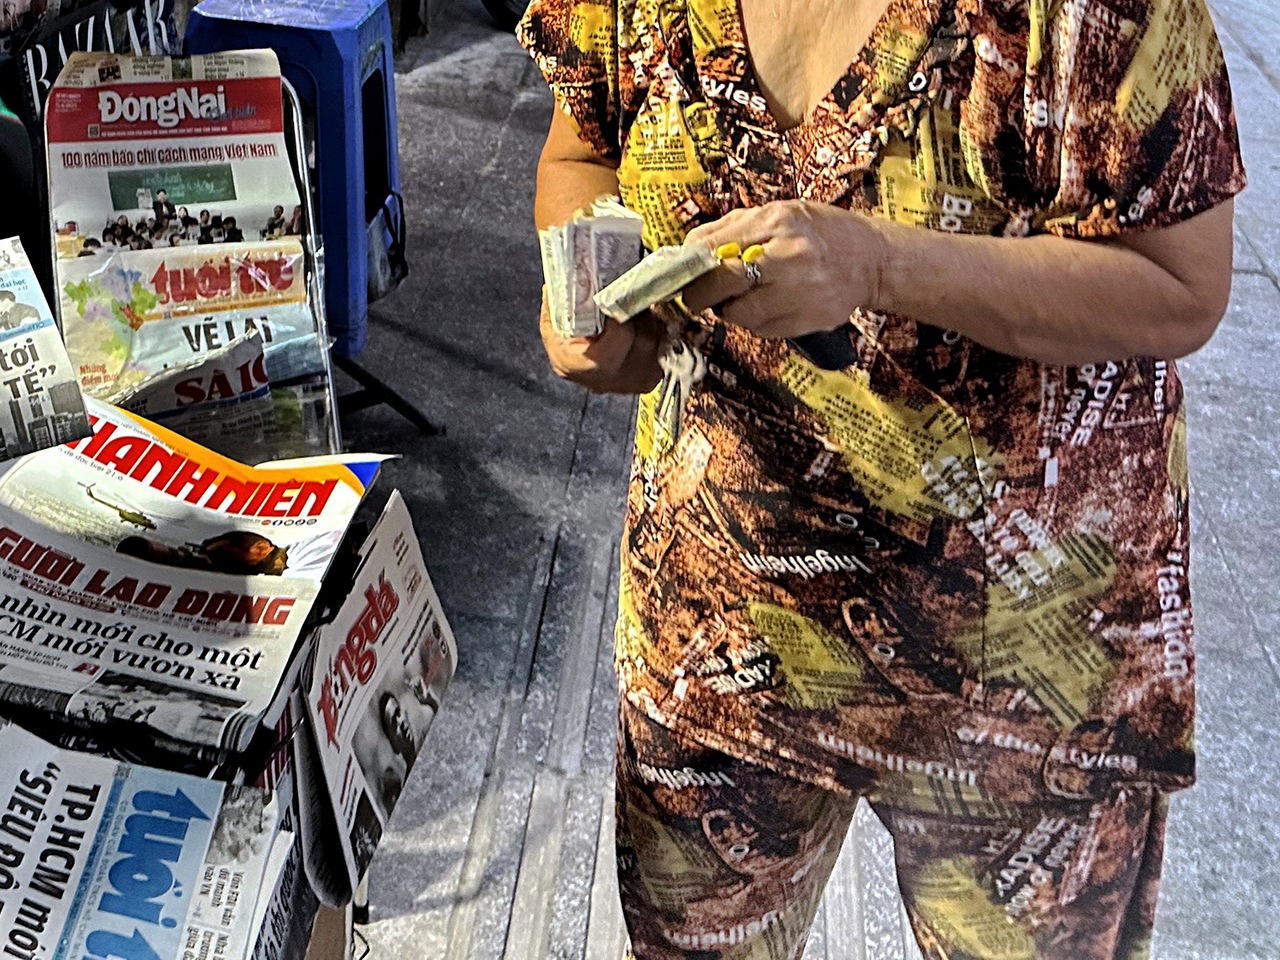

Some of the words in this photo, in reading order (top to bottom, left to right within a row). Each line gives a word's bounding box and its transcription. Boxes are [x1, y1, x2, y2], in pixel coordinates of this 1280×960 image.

[62, 150, 81, 167] 100
[84, 148, 110, 166] năm
[112, 146, 134, 164] báo
[136, 145, 156, 163] chí
[157, 145, 187, 162] cách
[189, 146, 222, 164] mạng
[224, 143, 247, 161] Việt
[249, 143, 277, 158] Nam
[182, 316, 223, 352] VẼ
[8, 357, 57, 402] TẾ”
[65, 414, 220, 505] HANH
[205, 473, 340, 517] NIÊN
[84, 569, 172, 608] LAO
[172, 588, 297, 625] ĐỘNG
[41, 630, 110, 662] mới
[111, 648, 196, 681] vươn
[200, 666, 242, 691] xa
[69, 617, 138, 645] mới
[137, 630, 194, 657] cho
[197, 646, 264, 672] một
[25, 782, 101, 900] TP.HCM
[98, 787, 212, 929] tuổi
